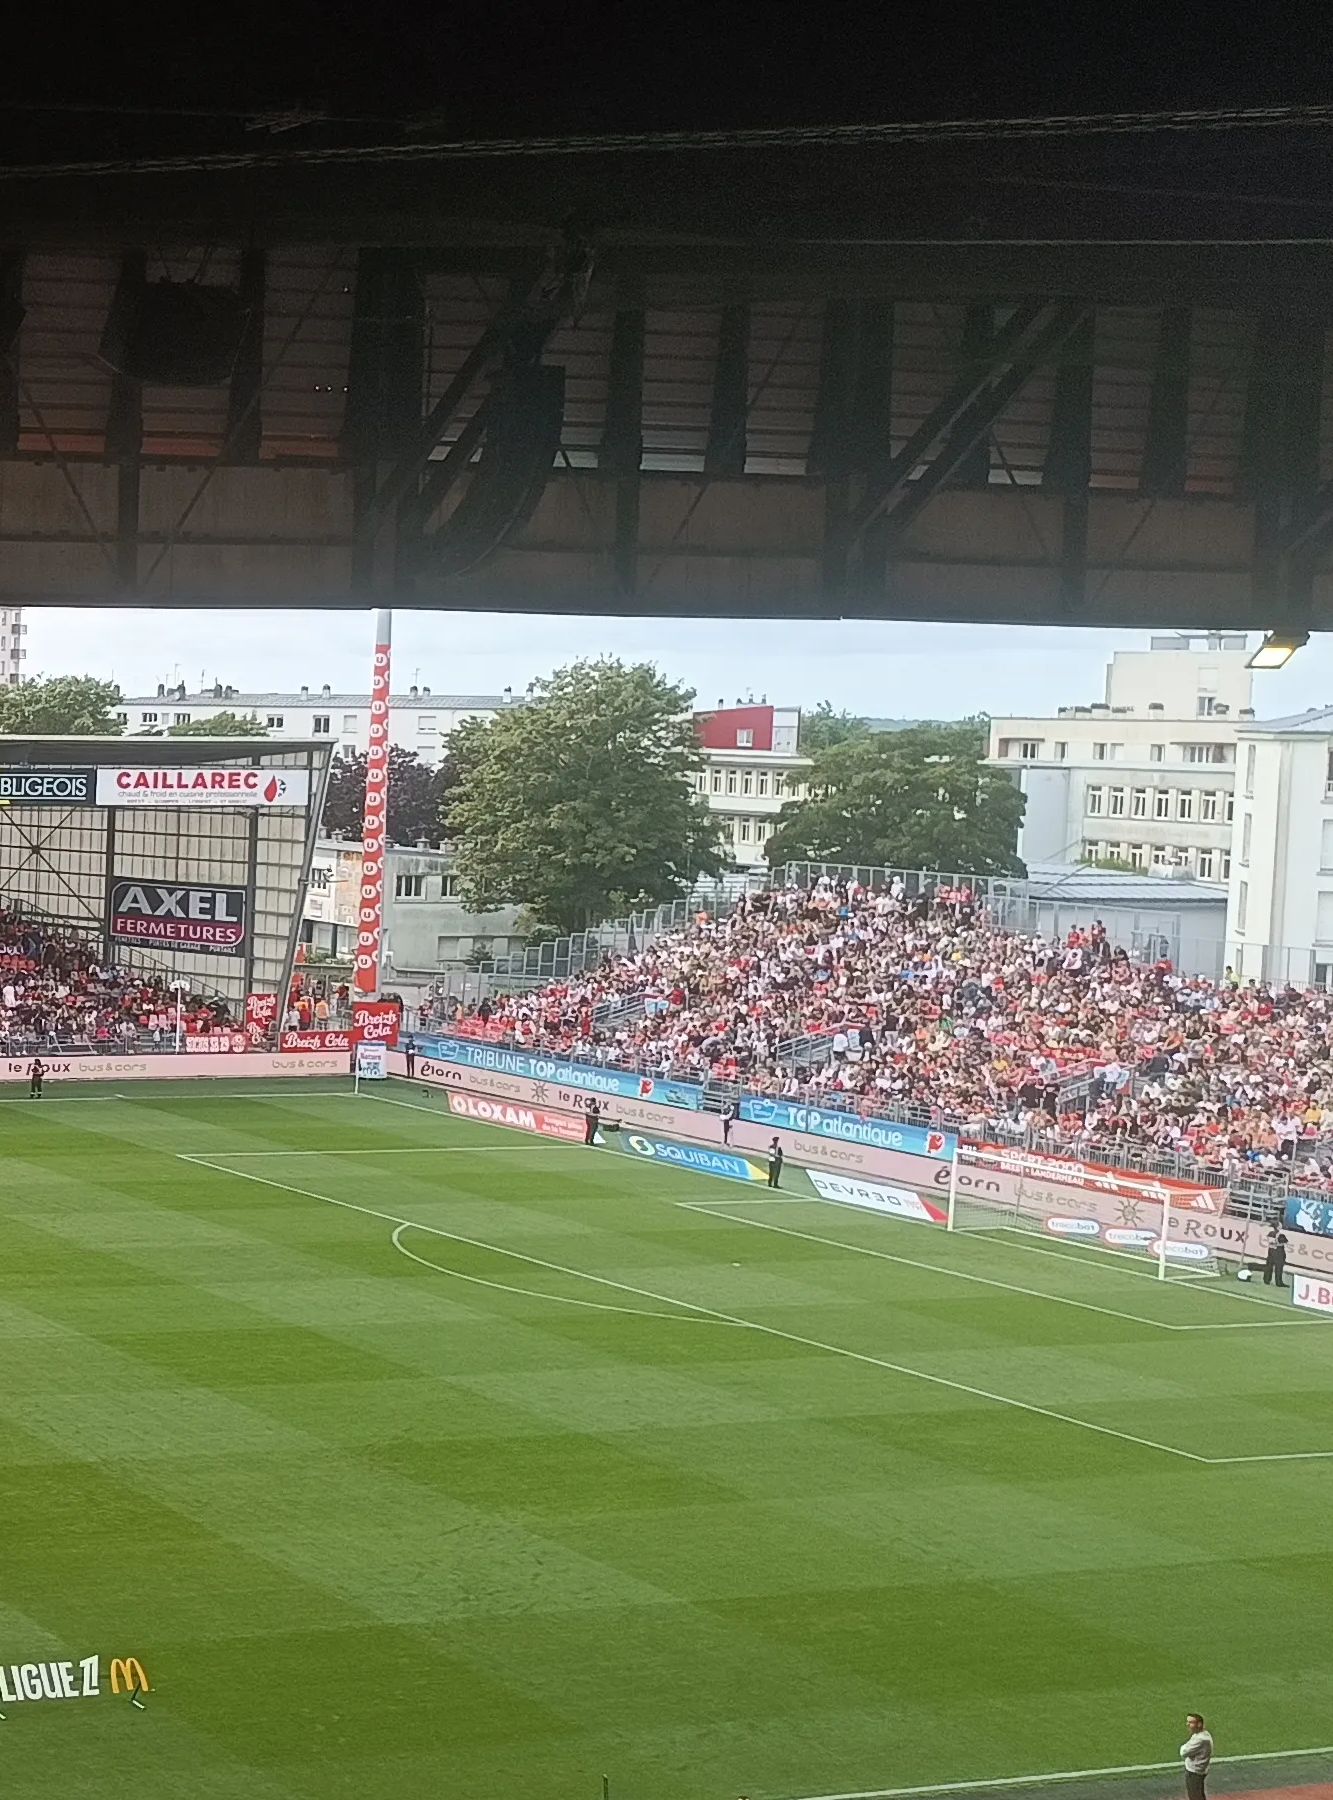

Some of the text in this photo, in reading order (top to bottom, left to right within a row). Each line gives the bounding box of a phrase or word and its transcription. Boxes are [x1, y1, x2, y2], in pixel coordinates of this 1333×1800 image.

[116, 771, 258, 789] CAILLAREC
[118, 886, 237, 922] AXEL
[116, 918, 236, 942] FERMETURES
[325, 1033, 349, 1048] Cola
[364, 1025, 393, 1039] Cola
[8, 1063, 22, 1073] le
[421, 1060, 462, 1081] élorn
[465, 1046, 620, 1092] TRIBUNE TOP atlantique
[467, 1097, 536, 1129] LOXAM
[823, 1117, 902, 1147] atlantique
[655, 1144, 740, 1173] SQUIBAN
[1184, 1219, 1249, 1243] Roux
